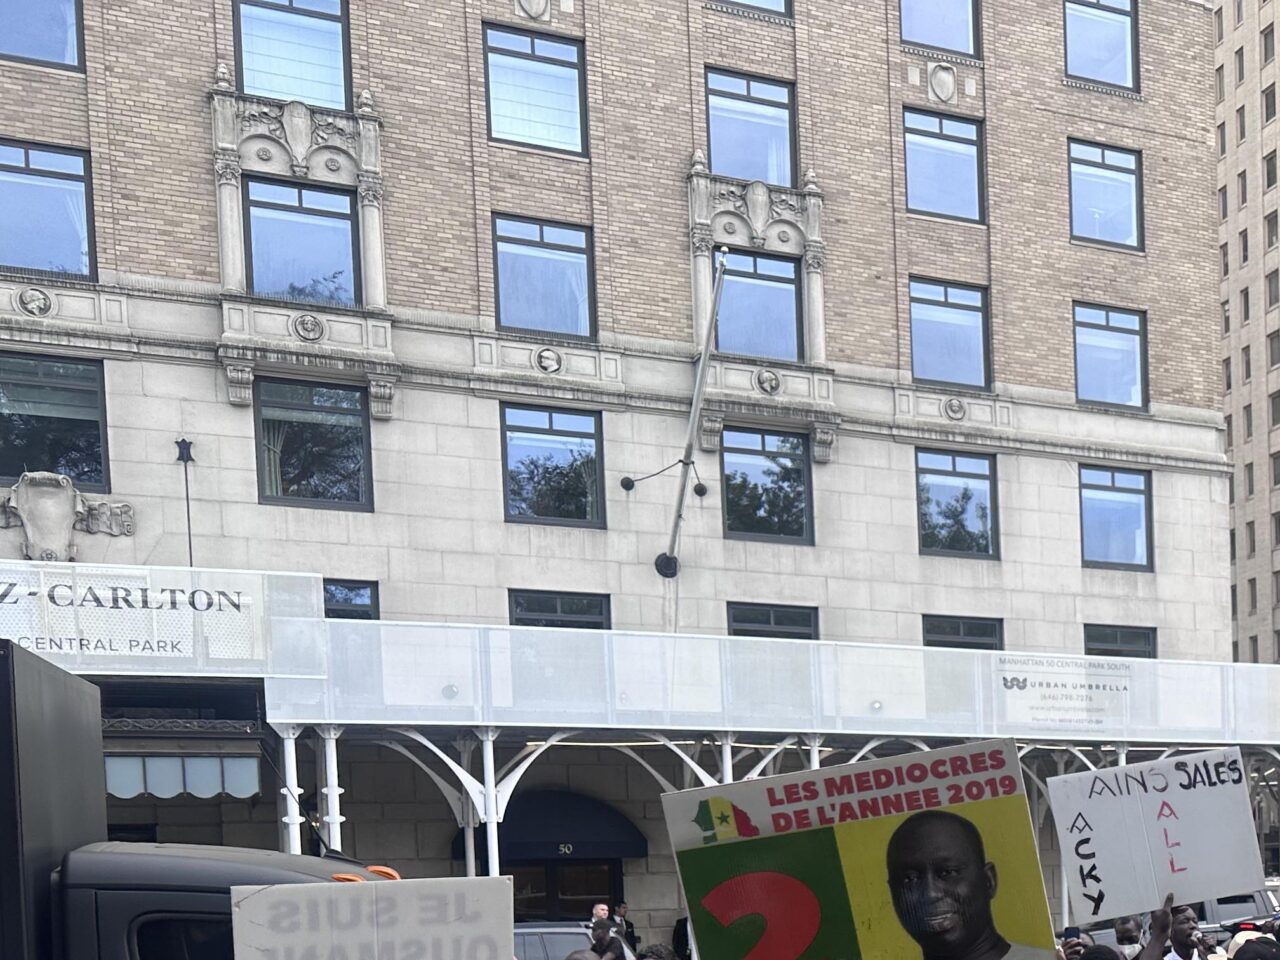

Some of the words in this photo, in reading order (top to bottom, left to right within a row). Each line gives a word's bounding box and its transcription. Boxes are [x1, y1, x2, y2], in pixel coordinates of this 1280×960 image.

[18, 636, 119, 652] CENTRAL
[129, 640, 184, 653] PARK
[999, 657, 1044, 667] MANHATTAN
[1056, 659, 1087, 669] CENTRAL
[1088, 660, 1105, 670] PARK
[1107, 662, 1130, 671] SOUTH
[1030, 681, 1067, 689] URBAN
[1072, 683, 1128, 692] UMBRELLA
[766, 783, 820, 808] LES
[824, 749, 1007, 798] MEDIOCRES
[1174, 758, 1243, 790] SALES
[771, 808, 813, 834] DE
[818, 787, 942, 827] L'ANNEE
[946, 774, 1018, 805] 2019
[558, 843, 574, 854] 50
